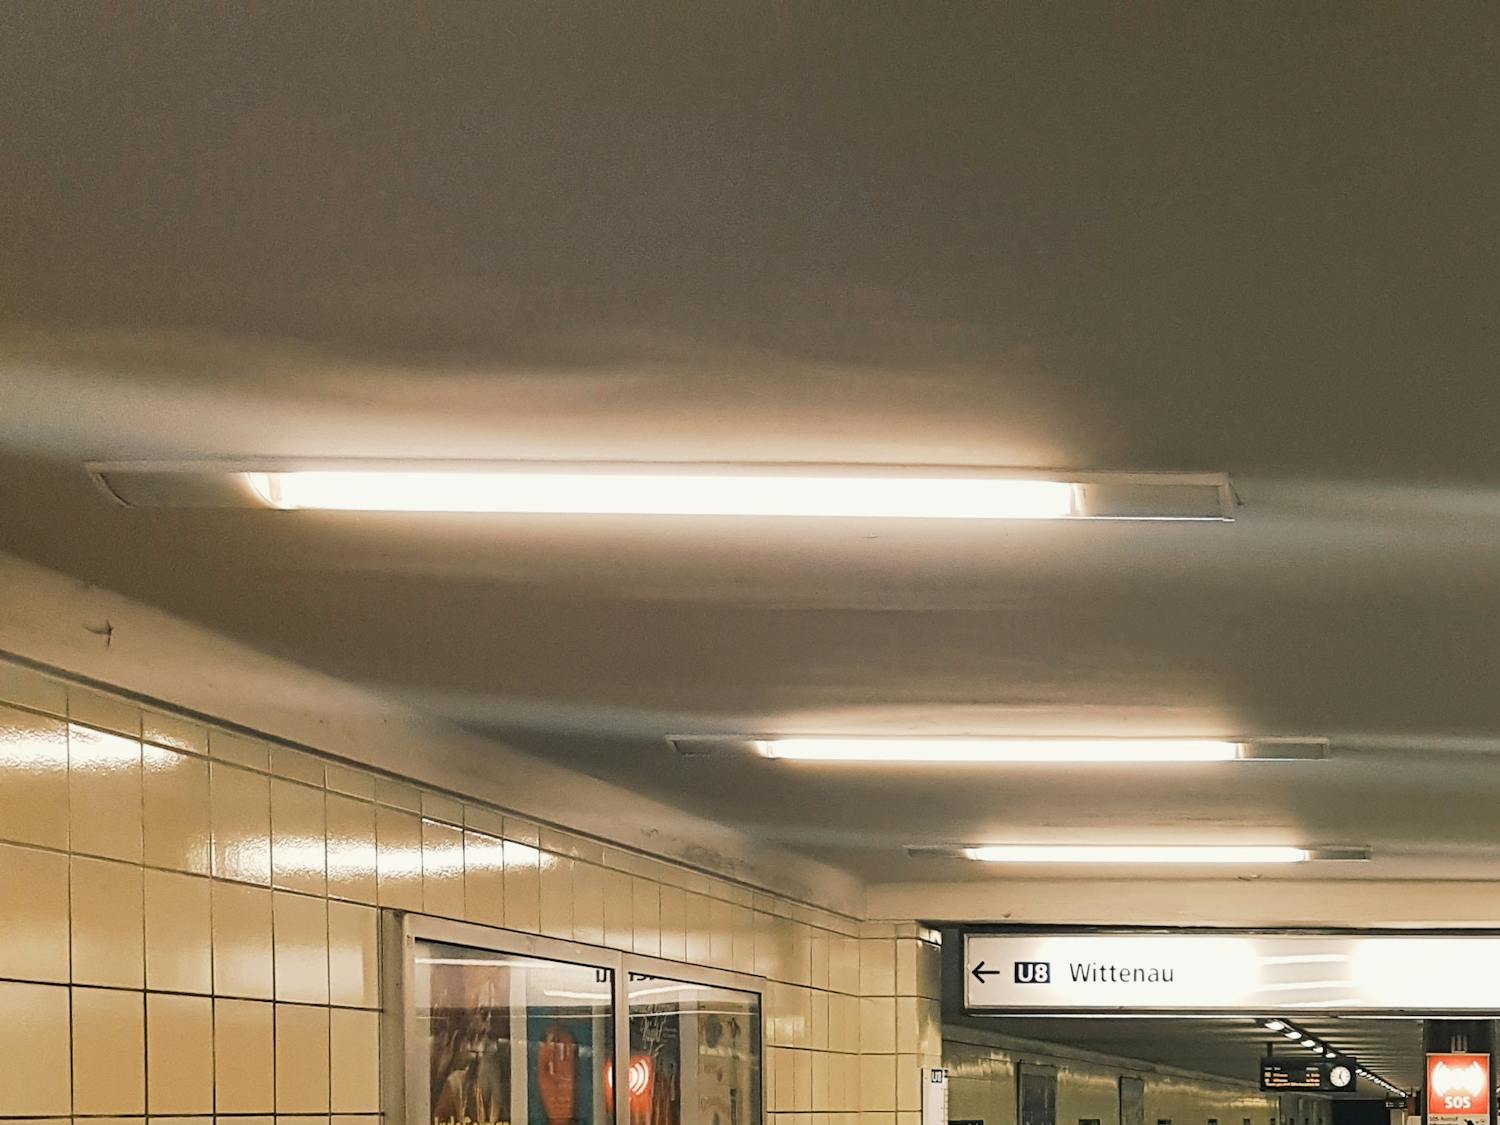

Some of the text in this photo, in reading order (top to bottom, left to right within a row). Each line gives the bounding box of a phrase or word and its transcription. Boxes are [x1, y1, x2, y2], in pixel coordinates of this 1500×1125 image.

[1018, 962, 1174, 983] U8 Wittenau
[1444, 1095, 1472, 1110] SOS
